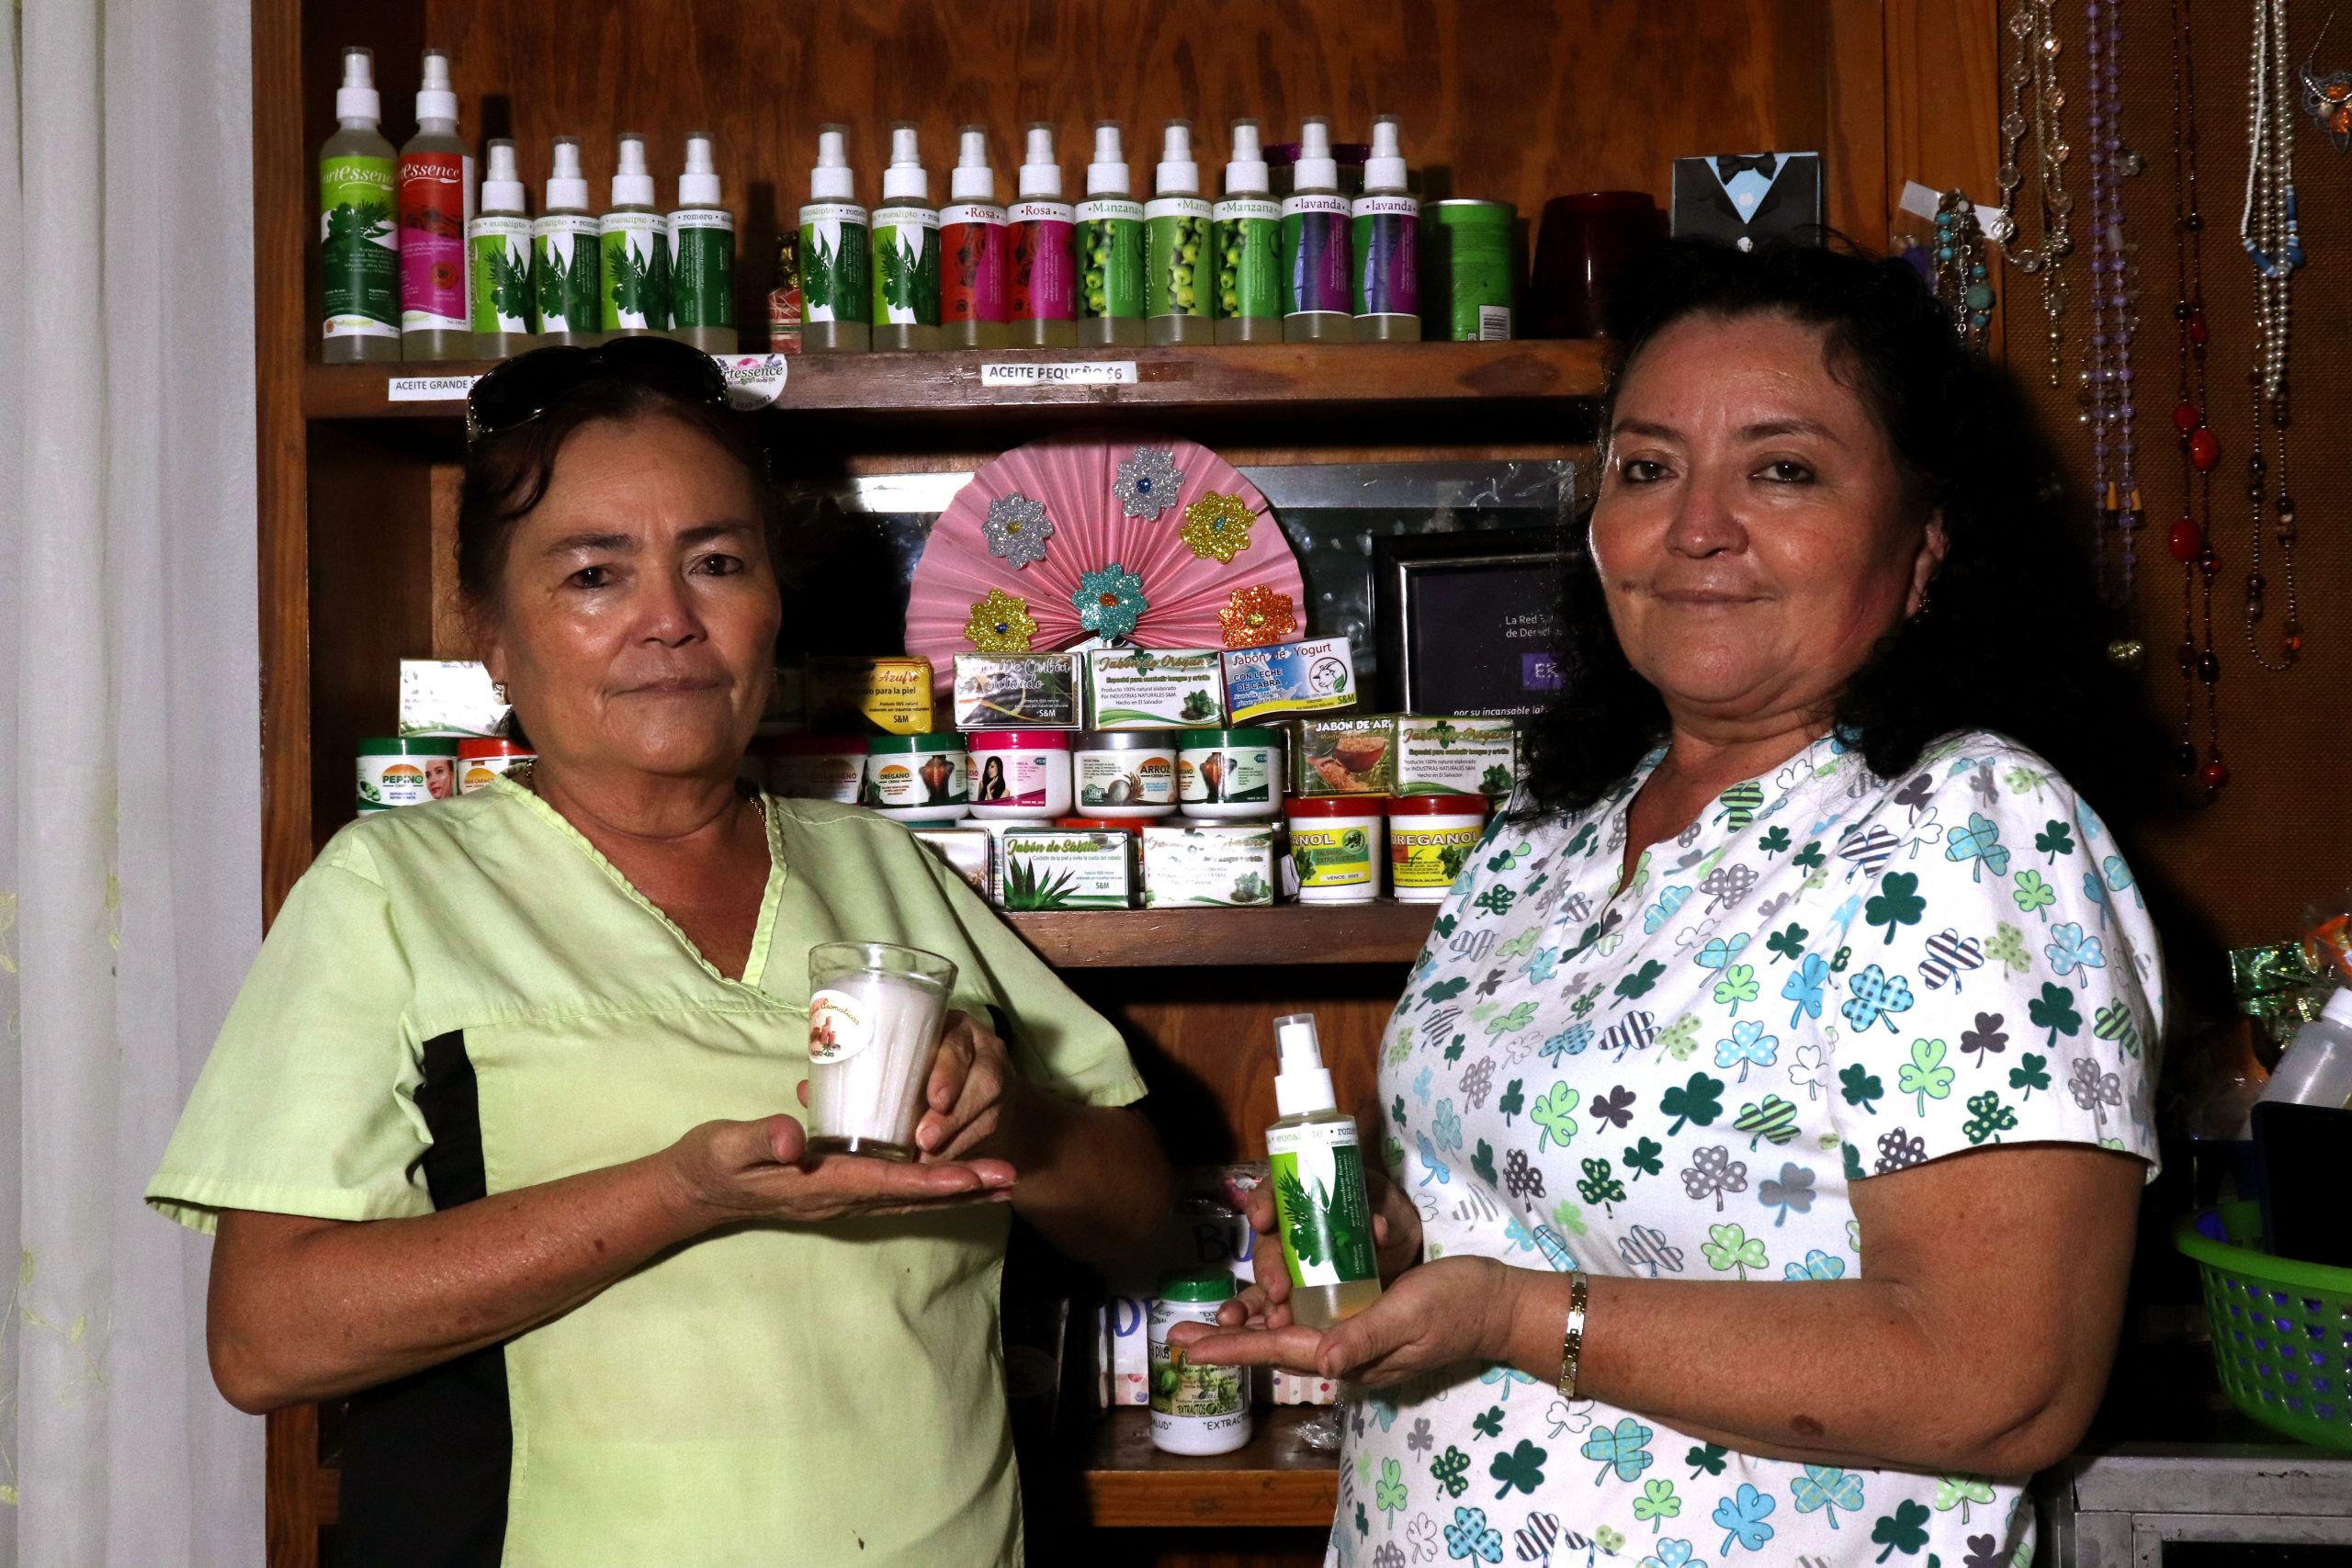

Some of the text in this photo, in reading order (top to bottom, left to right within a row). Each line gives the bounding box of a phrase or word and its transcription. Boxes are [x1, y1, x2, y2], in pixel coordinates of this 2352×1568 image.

[322, 166, 395, 183] artessenc
[401, 163, 459, 180] tessence
[1092, 203, 1139, 214] Manzana
[1182, 199, 1212, 212] Manz
[1227, 202, 1273, 213] Manzana
[1301, 198, 1341, 210] lavanda
[1372, 199, 1412, 212] lavanda
[970, 208, 995, 220] Rosa
[1025, 205, 1051, 215] Rosa
[683, 213, 713, 221] romero
[721, 366, 783, 379] rtessence
[989, 367, 1034, 378] ACEITE
[1037, 366, 1102, 380] PEQUÑ
[396, 381, 427, 390] ACEITE
[429, 380, 468, 389] GRANDE
[1506, 615, 1537, 626] La Red
[1506, 628, 1518, 637] de
[1233, 653, 1266, 666] Jabón
[1294, 643, 1332, 657] Yogurt
[878, 670, 920, 684] Azufre
[1254, 669, 1283, 679] LECHE
[902, 686, 916, 695] piel
[1251, 681, 1282, 689] CABRA
[1338, 694, 1355, 705] S&M
[1039, 709, 1056, 717] S&M
[1470, 708, 1480, 716] su
[1482, 705, 1530, 716] incansable
[893, 715, 909, 723] S&M
[1316, 719, 1352, 732] JABÓN
[1356, 720, 1370, 729] DE
[1140, 764, 1170, 774] ARROZ
[1291, 833, 1336, 846] ANOL
[1007, 838, 1046, 856] Jabón
[1046, 840, 1061, 852] de
[1276, 1130, 1323, 1143] eucalto
[1152, 1419, 1172, 1430] ALUD"
[1203, 1416, 1242, 1431] "EXTRAC
